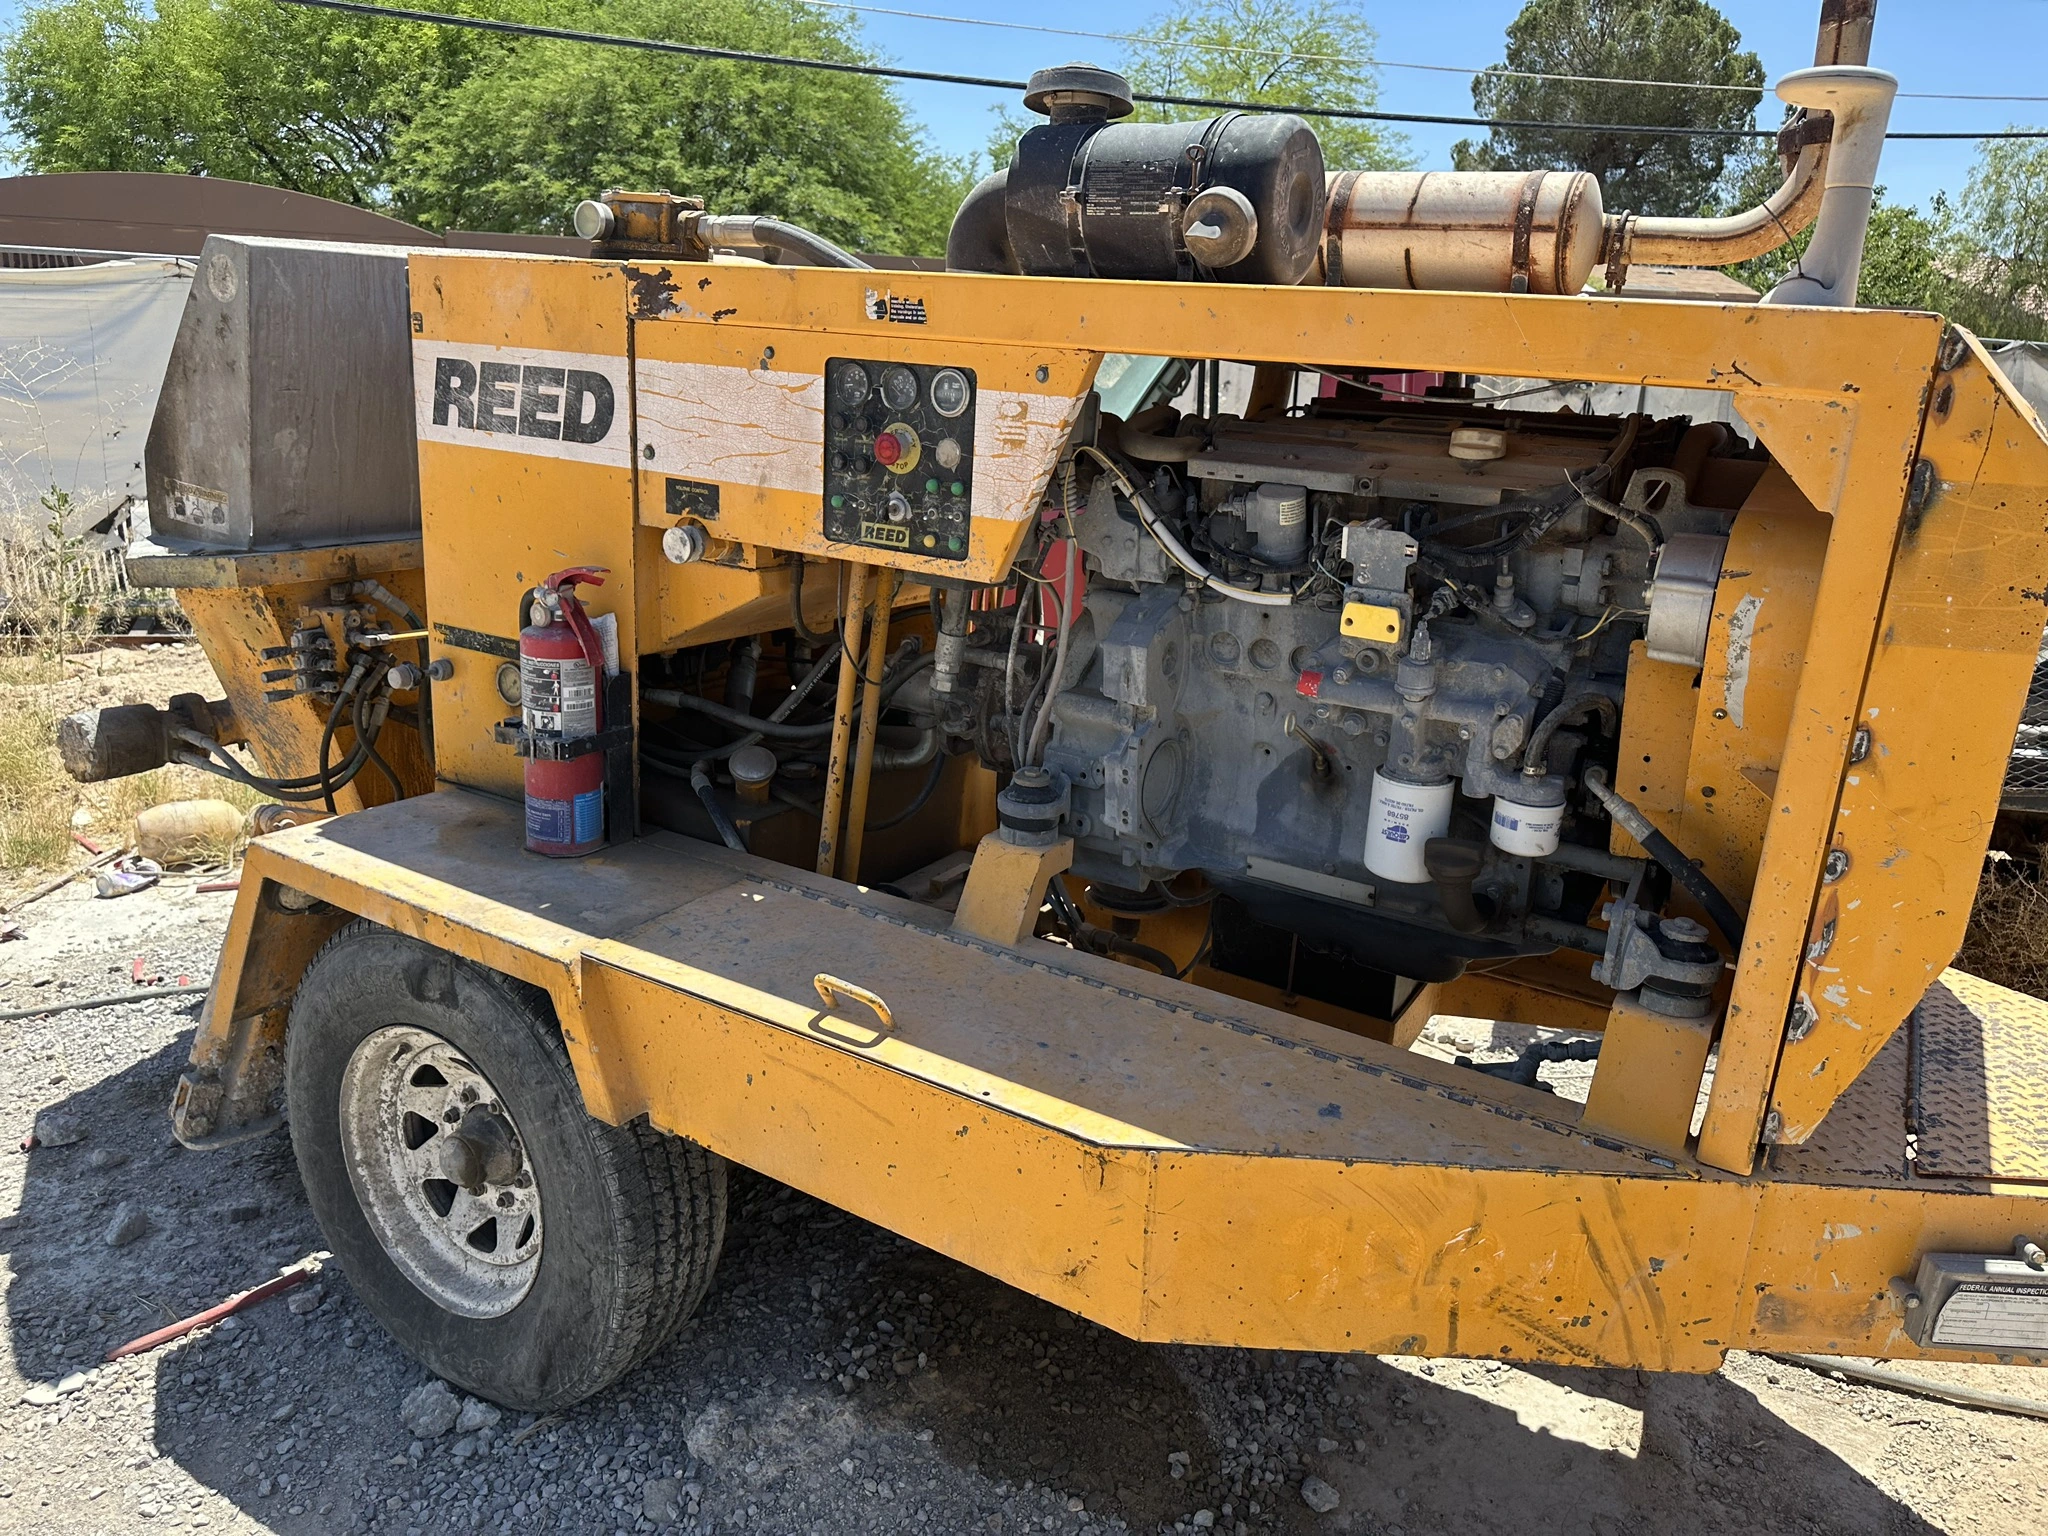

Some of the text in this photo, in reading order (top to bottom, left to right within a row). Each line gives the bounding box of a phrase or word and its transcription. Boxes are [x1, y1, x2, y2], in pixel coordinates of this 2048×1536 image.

[433, 357, 615, 444] REED
[865, 526, 907, 543] REED
[1387, 810, 1409, 820] 85768
